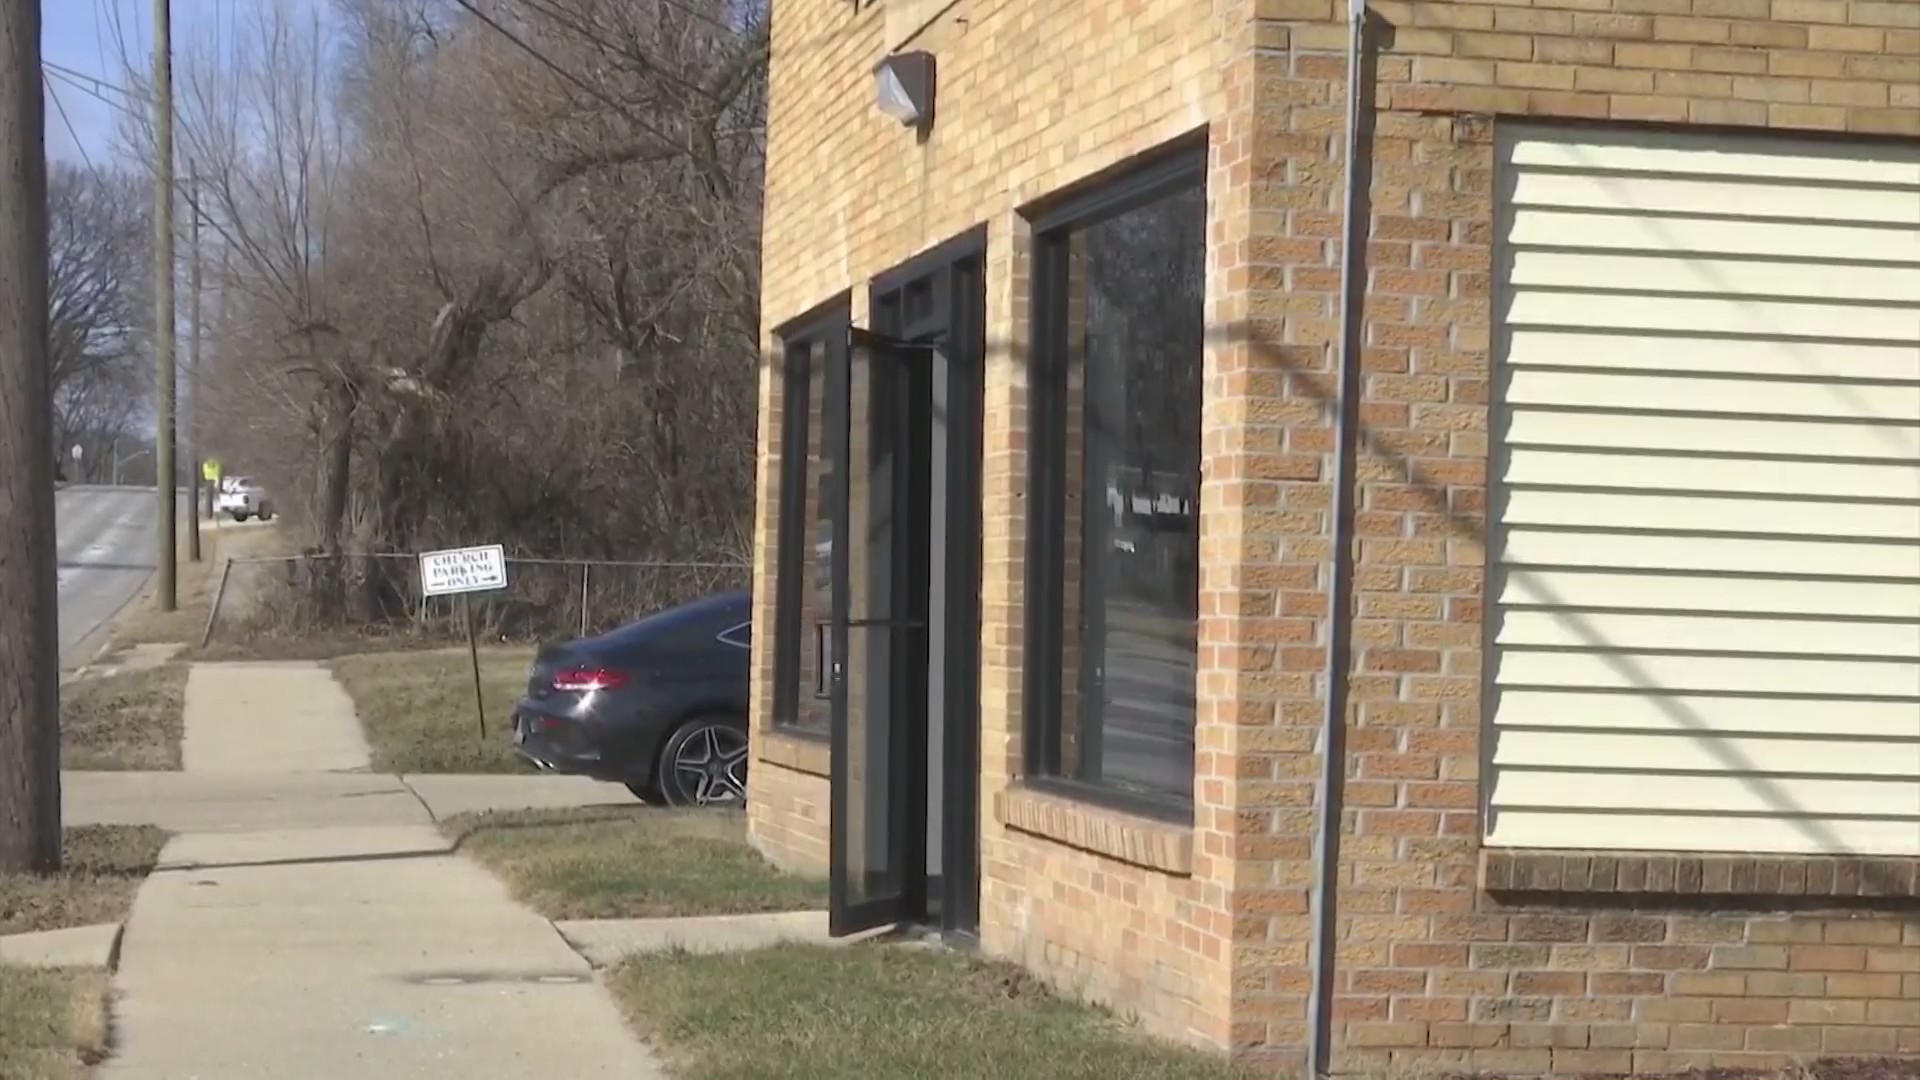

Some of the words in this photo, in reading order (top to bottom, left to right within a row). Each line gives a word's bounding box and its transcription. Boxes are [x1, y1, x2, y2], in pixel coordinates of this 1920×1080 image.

[433, 551, 488, 567] CHURCH
[433, 563, 493, 578] PARKING
[447, 575, 479, 587] ONLY
